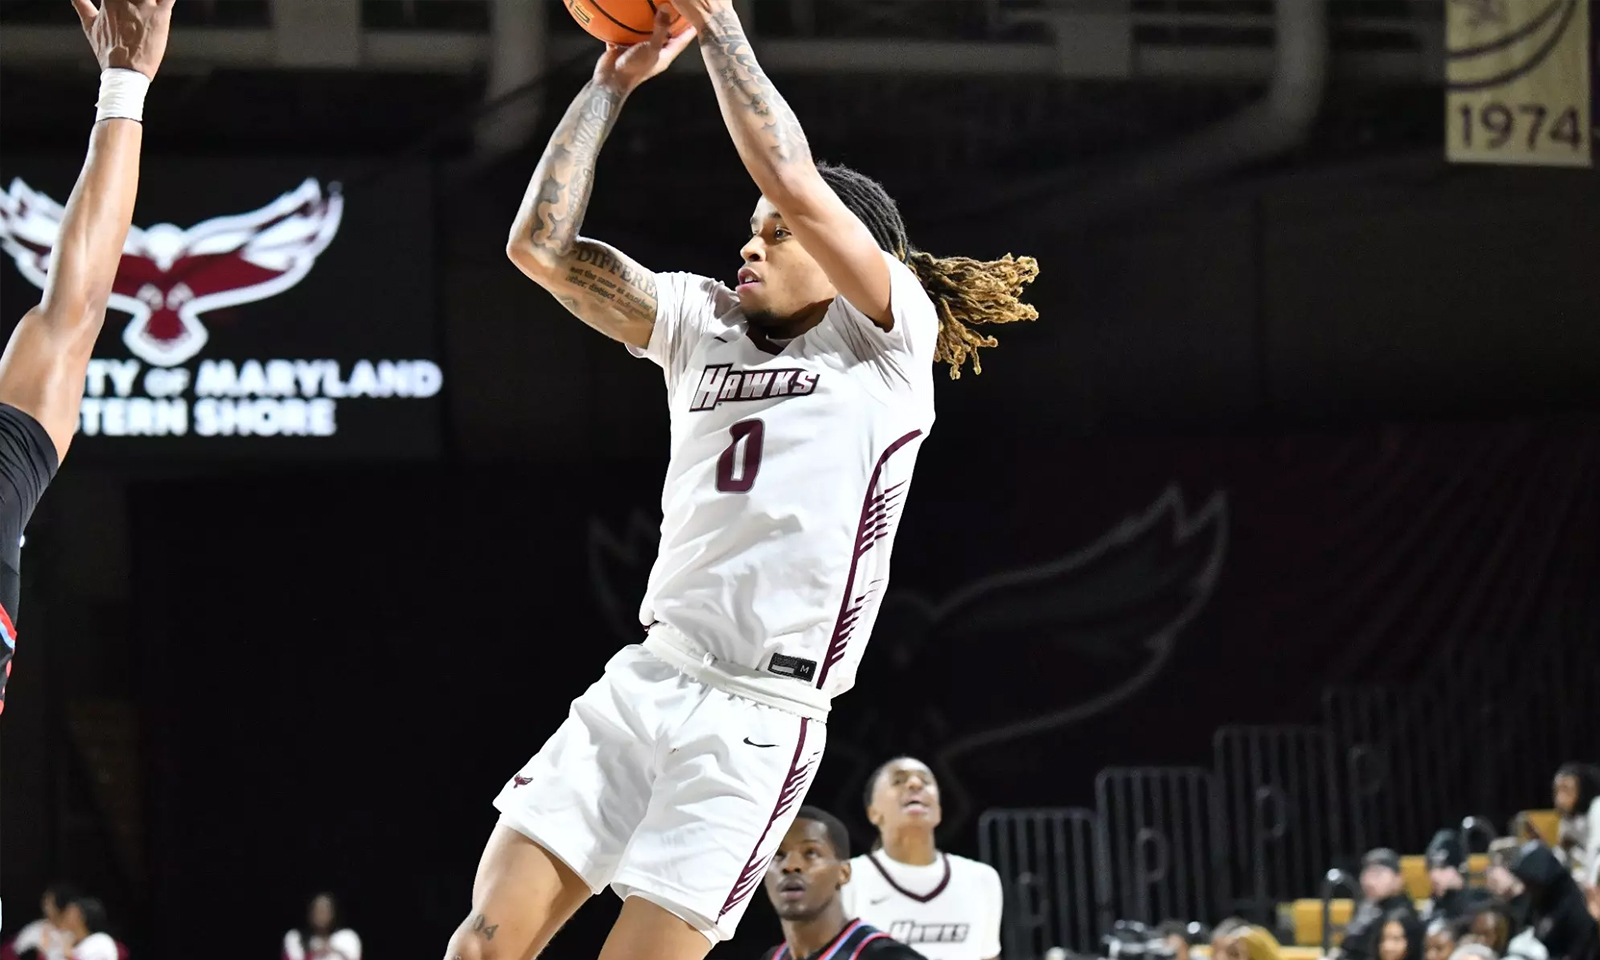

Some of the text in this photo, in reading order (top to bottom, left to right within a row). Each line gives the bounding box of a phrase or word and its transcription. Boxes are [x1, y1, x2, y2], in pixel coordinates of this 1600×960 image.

[1459, 103, 1581, 149] 1974
[194, 359, 443, 398] MARYLAND
[689, 363, 820, 412] HAWKS
[75, 396, 337, 437] TERN SHORE
[715, 417, 765, 494] 0
[800, 664, 810, 674] M
